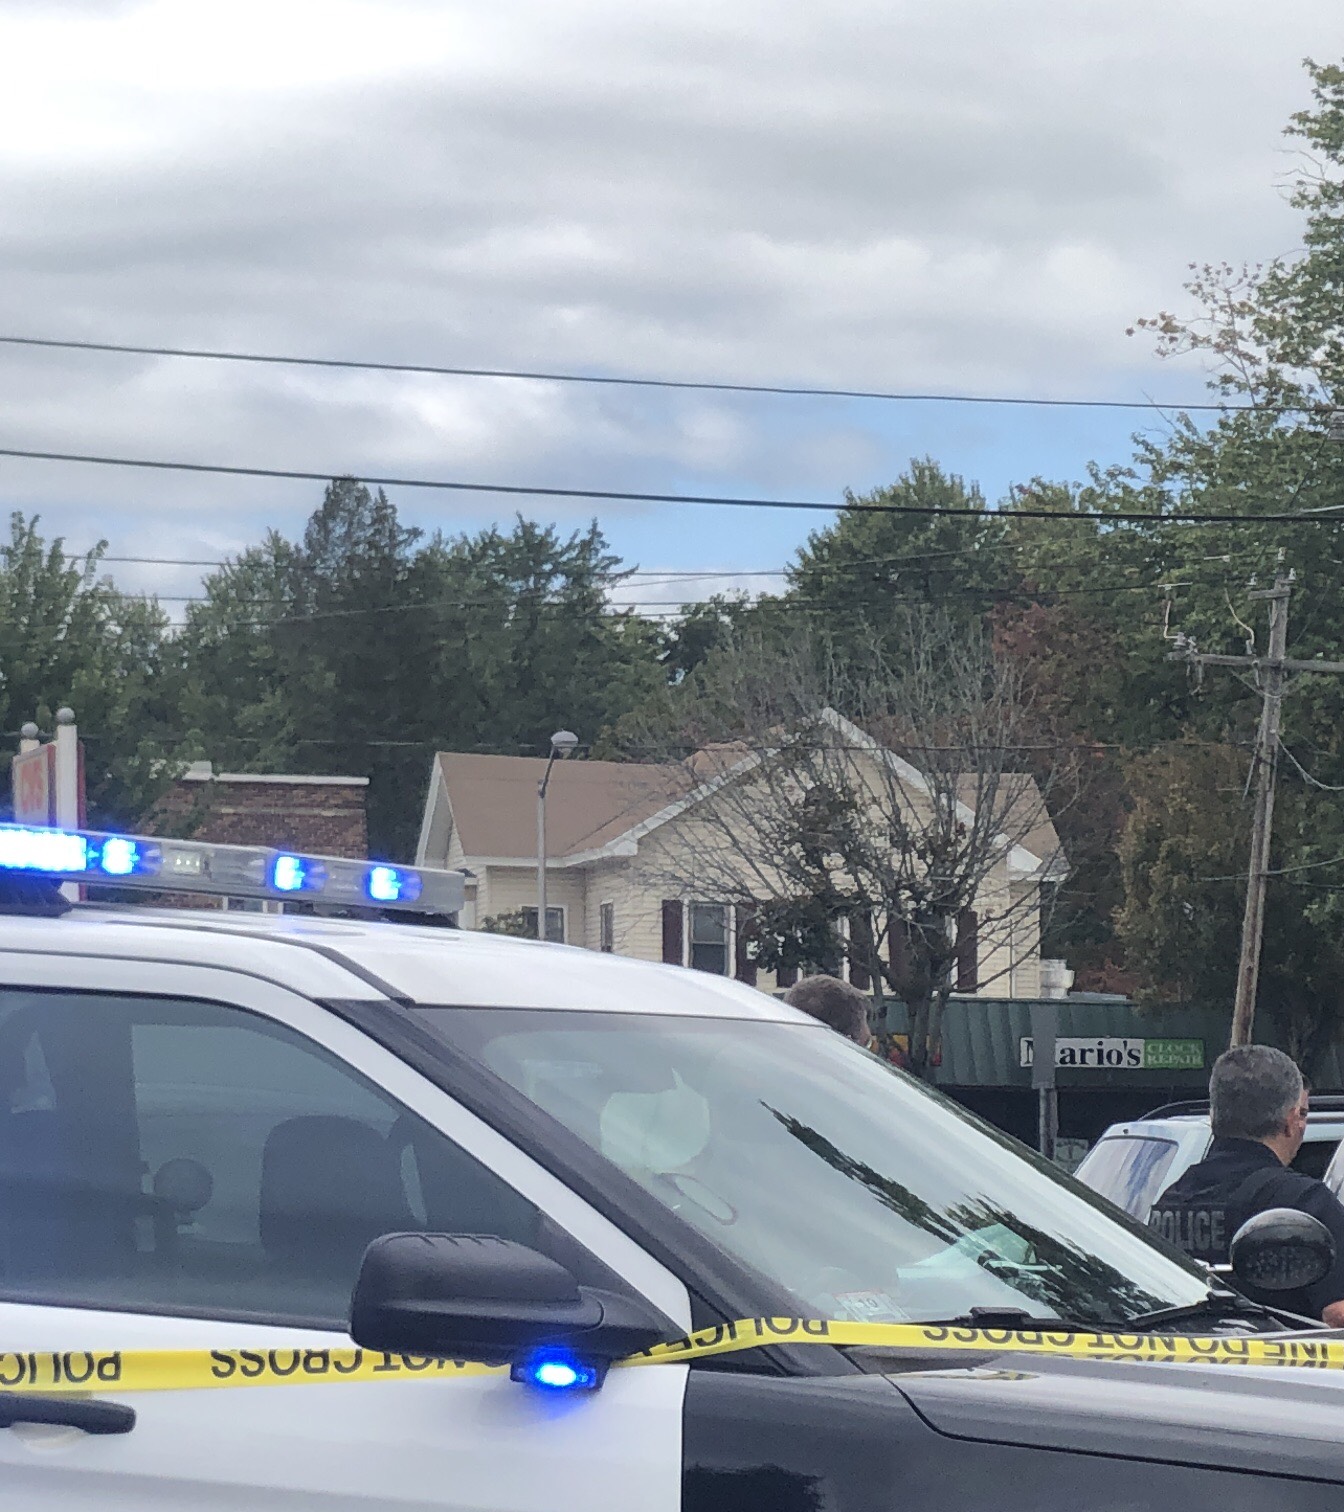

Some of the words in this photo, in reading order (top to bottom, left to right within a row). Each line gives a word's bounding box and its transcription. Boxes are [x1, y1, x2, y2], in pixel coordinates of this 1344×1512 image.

[1147, 1043, 1200, 1053] CLOCK
[1147, 1054, 1203, 1065] REPAIR
[1150, 1210, 1226, 1251] POLICE
